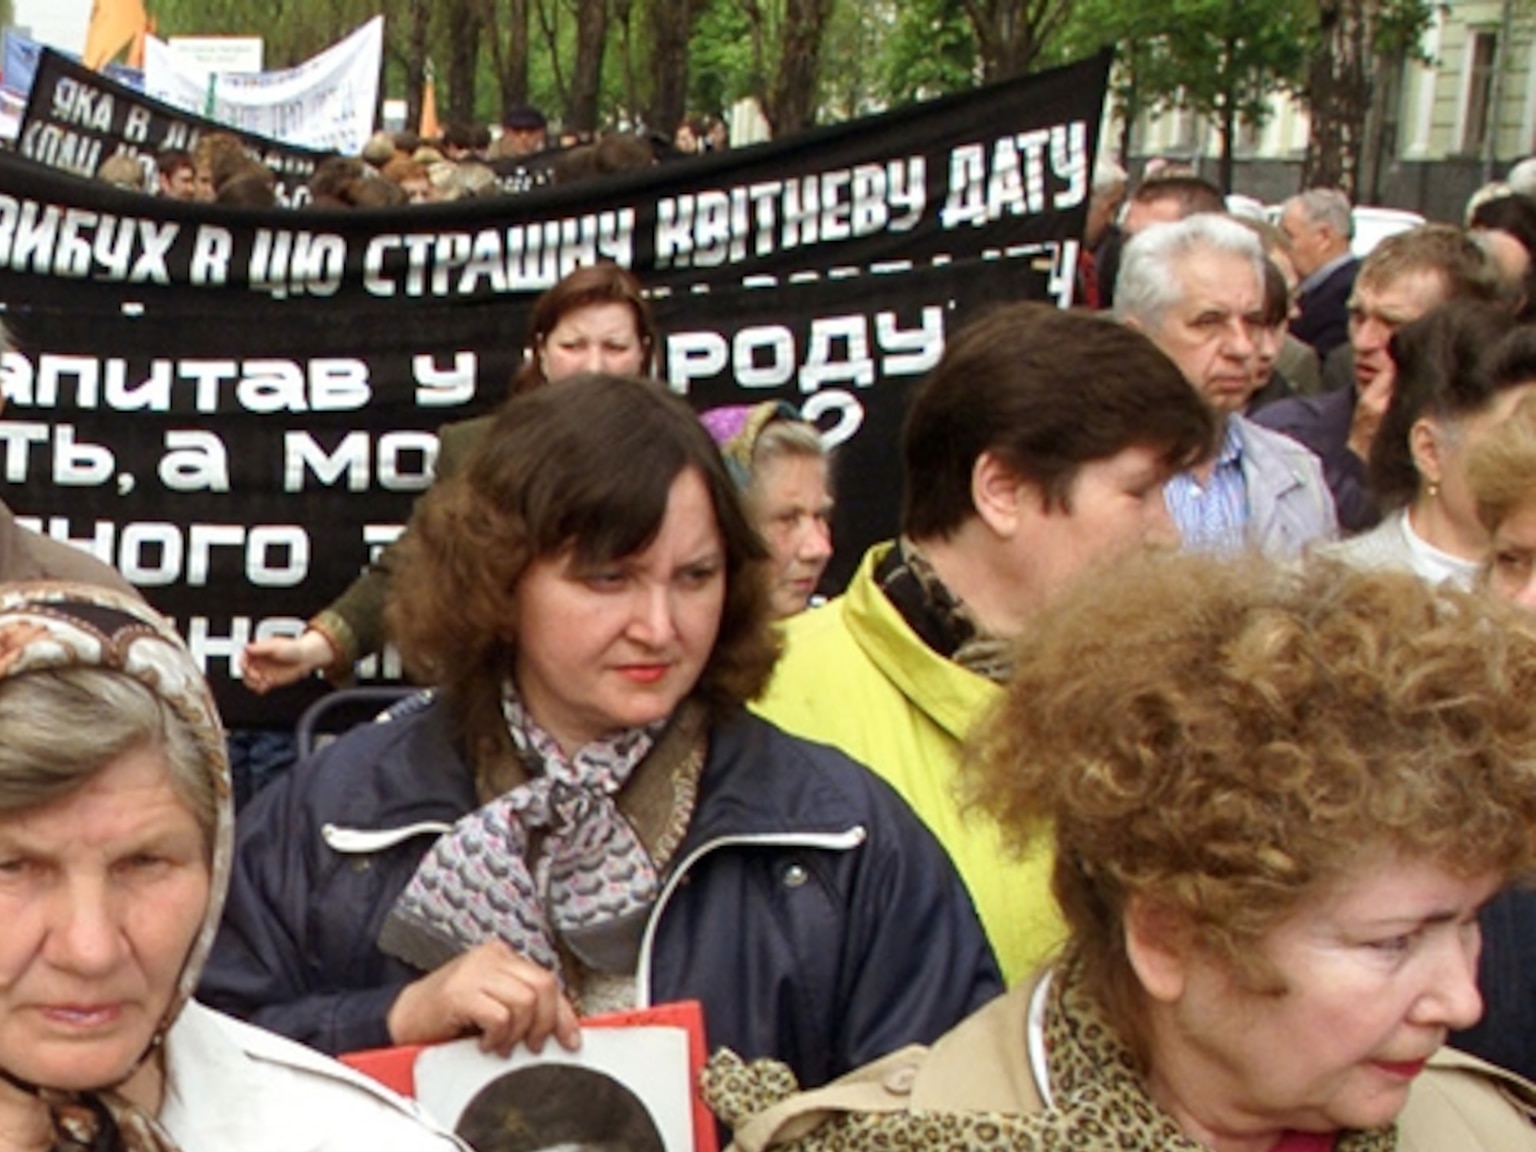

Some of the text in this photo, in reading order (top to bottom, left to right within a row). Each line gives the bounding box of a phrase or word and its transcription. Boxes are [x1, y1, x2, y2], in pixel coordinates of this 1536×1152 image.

[190, 223, 233, 286] В
[249, 229, 346, 298] ЦЮ
[366, 208, 635, 296] СТРАШНУ
[655, 156, 927, 268] КВІТНЕВУ
[941, 121, 1087, 229] ДАТУ
